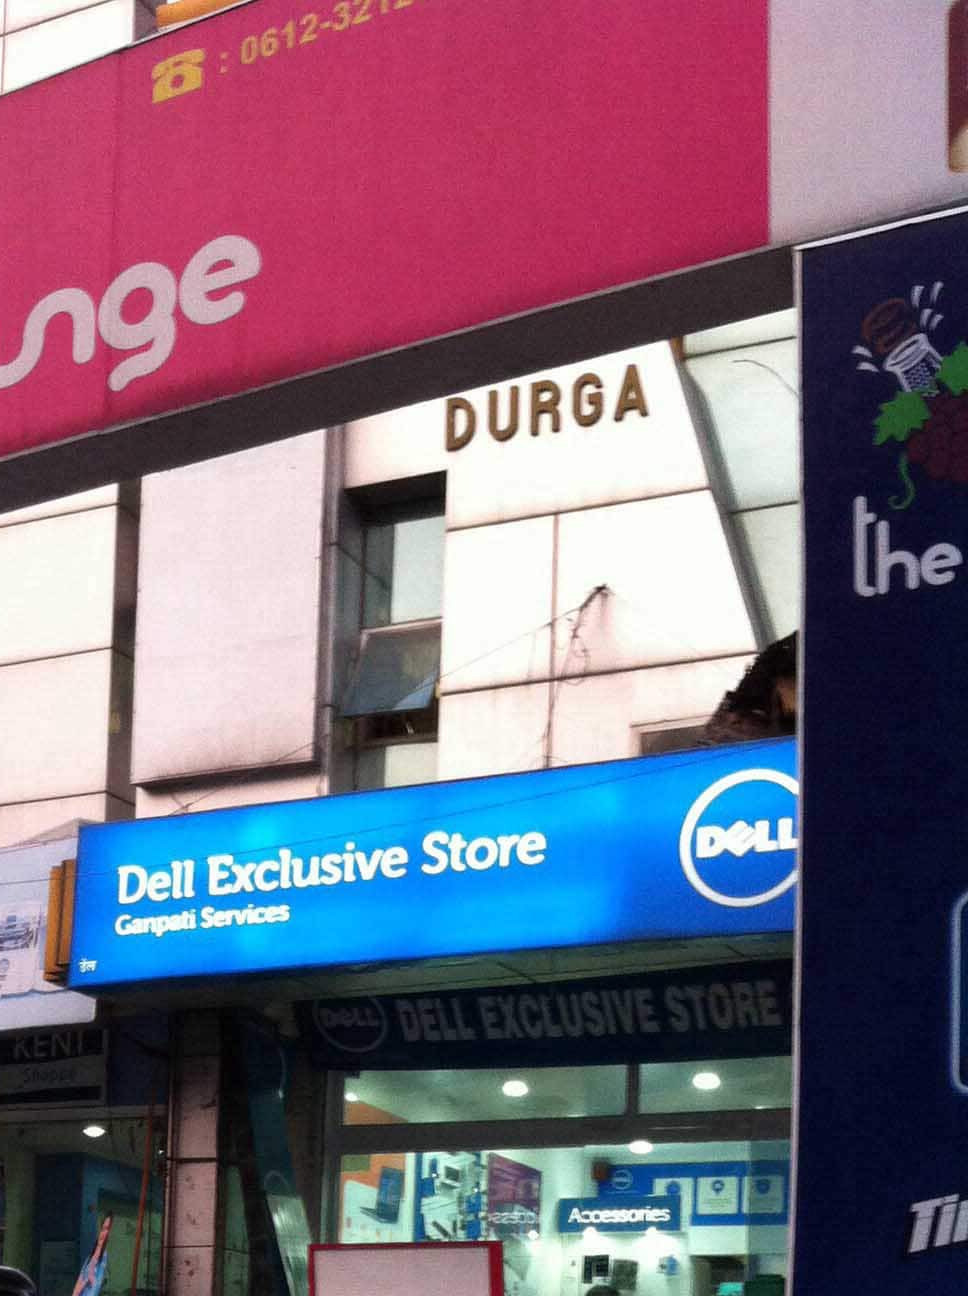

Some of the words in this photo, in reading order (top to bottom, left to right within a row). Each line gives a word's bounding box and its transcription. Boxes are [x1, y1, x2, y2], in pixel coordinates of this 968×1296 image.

[445, 364, 649, 453] DURGA
[853, 495, 963, 597] the
[117, 859, 195, 905] Dell
[206, 841, 409, 896] Exclusive
[421, 830, 548, 875] Store
[696, 817, 799, 859] DELL
[115, 909, 197, 937] Ganpati
[200, 903, 291, 929] Services
[397, 997, 479, 1042] DELL
[478, 988, 660, 1040] EXCLUSIVE
[665, 979, 782, 1034] STORE
[567, 1206, 671, 1224] Accessories
